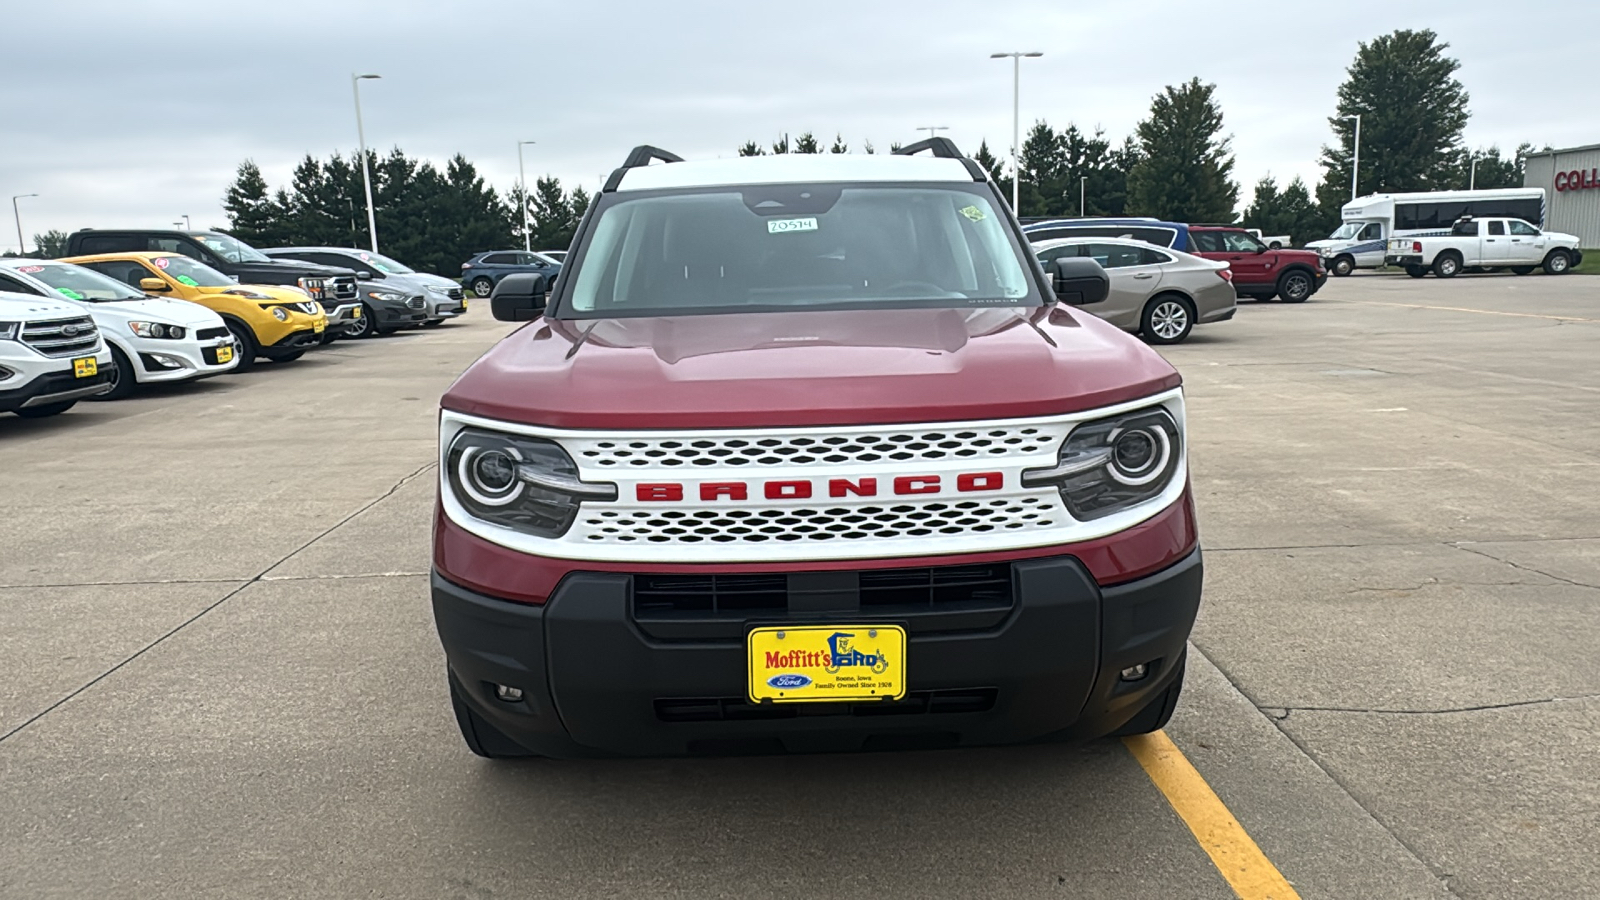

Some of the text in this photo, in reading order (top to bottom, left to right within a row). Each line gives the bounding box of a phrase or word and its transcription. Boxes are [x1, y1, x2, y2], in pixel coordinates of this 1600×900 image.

[1555, 168, 1600, 192] COLL
[635, 471, 1004, 502] BRONCO
[765, 649, 831, 669] Moffitt's
[776, 675, 803, 687] Ford
